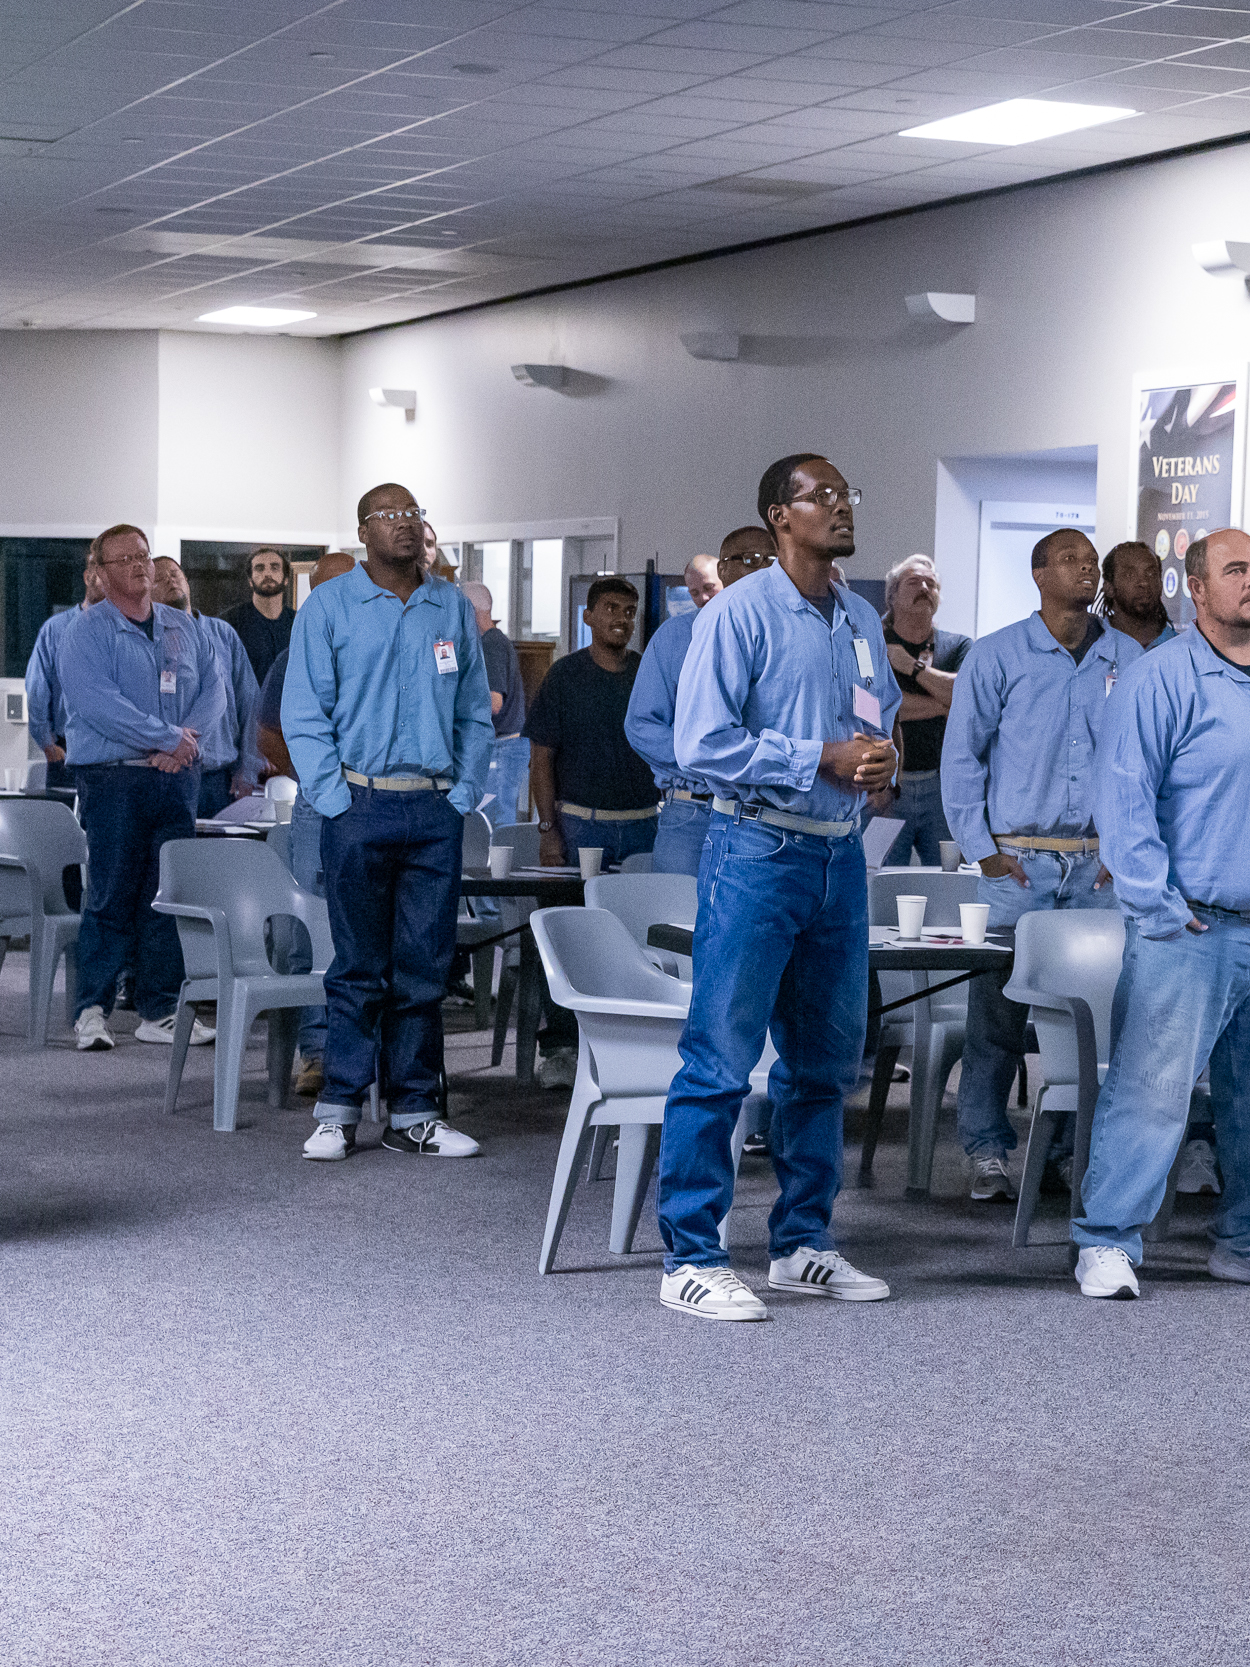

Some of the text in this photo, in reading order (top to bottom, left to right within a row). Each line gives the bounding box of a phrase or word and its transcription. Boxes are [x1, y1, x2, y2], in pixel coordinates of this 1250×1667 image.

[1152, 454, 1220, 477] VETERANS
[1171, 482, 1199, 504] DAY
[1157, 512, 1186, 521] NOVEMBER
[1141, 1069, 1188, 1100] INMATE
